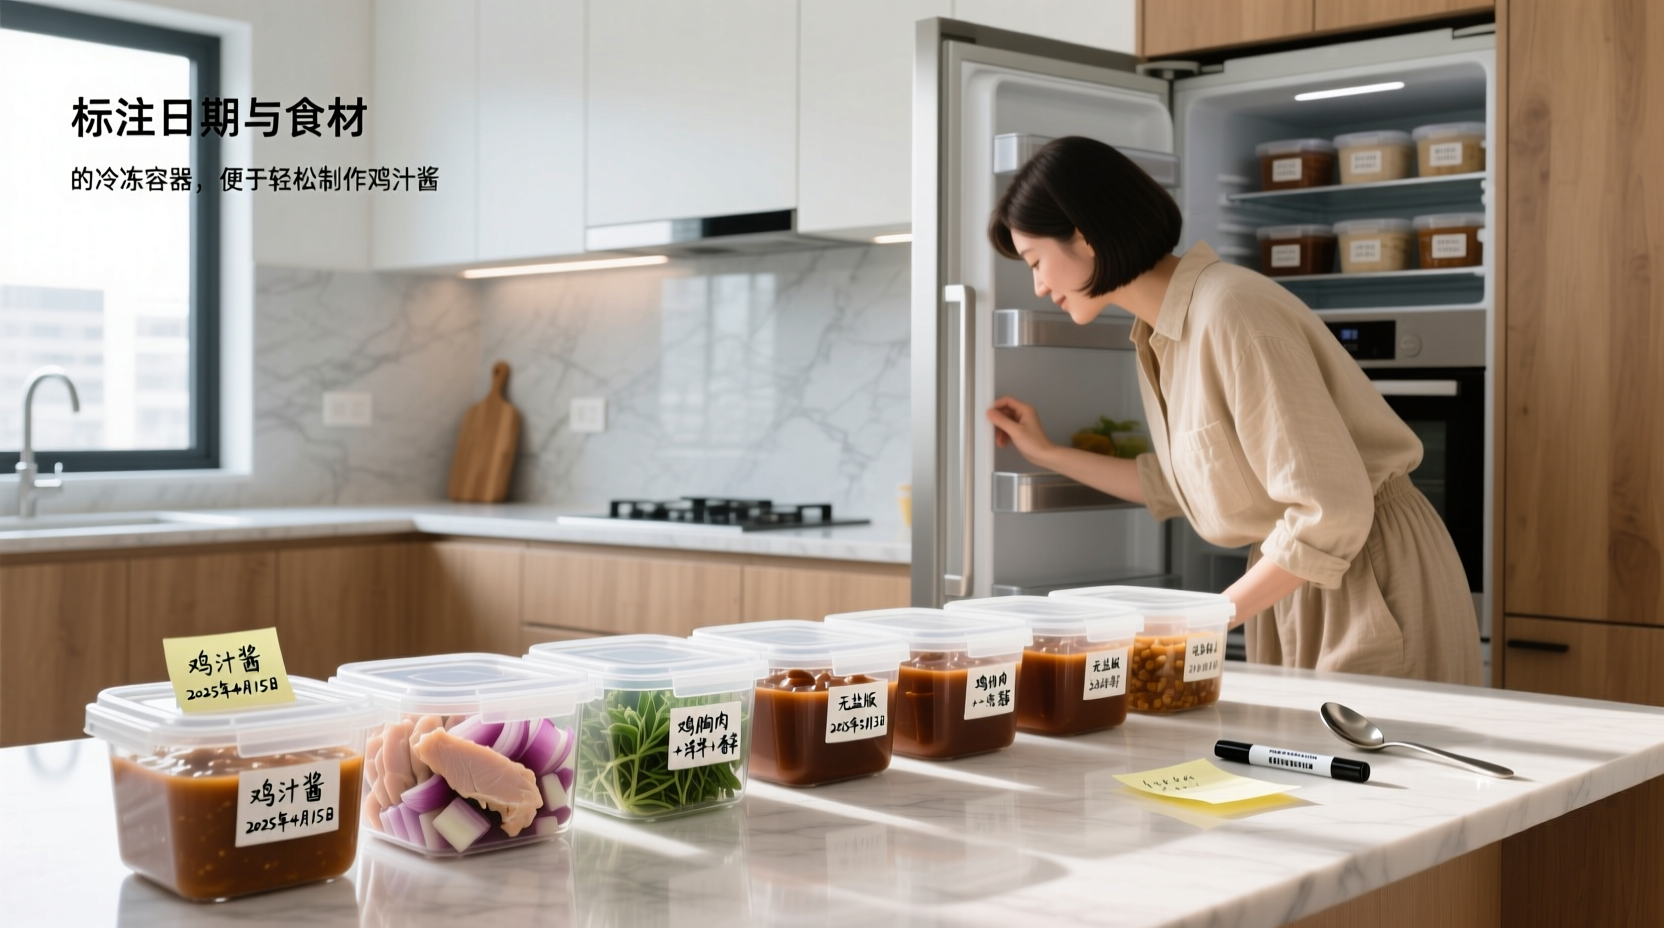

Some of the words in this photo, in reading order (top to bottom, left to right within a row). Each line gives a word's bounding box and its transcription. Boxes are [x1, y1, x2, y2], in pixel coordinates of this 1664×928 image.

[188, 644, 260, 676] 鸡汁酱
[186, 677, 278, 701] 2025年4月15日
[838, 691, 878, 712] 无盐版
[677, 710, 729, 736] 鸡胸肉
[249, 770, 325, 808] 鸡汁酱
[245, 806, 334, 835] 2025年4月15日
